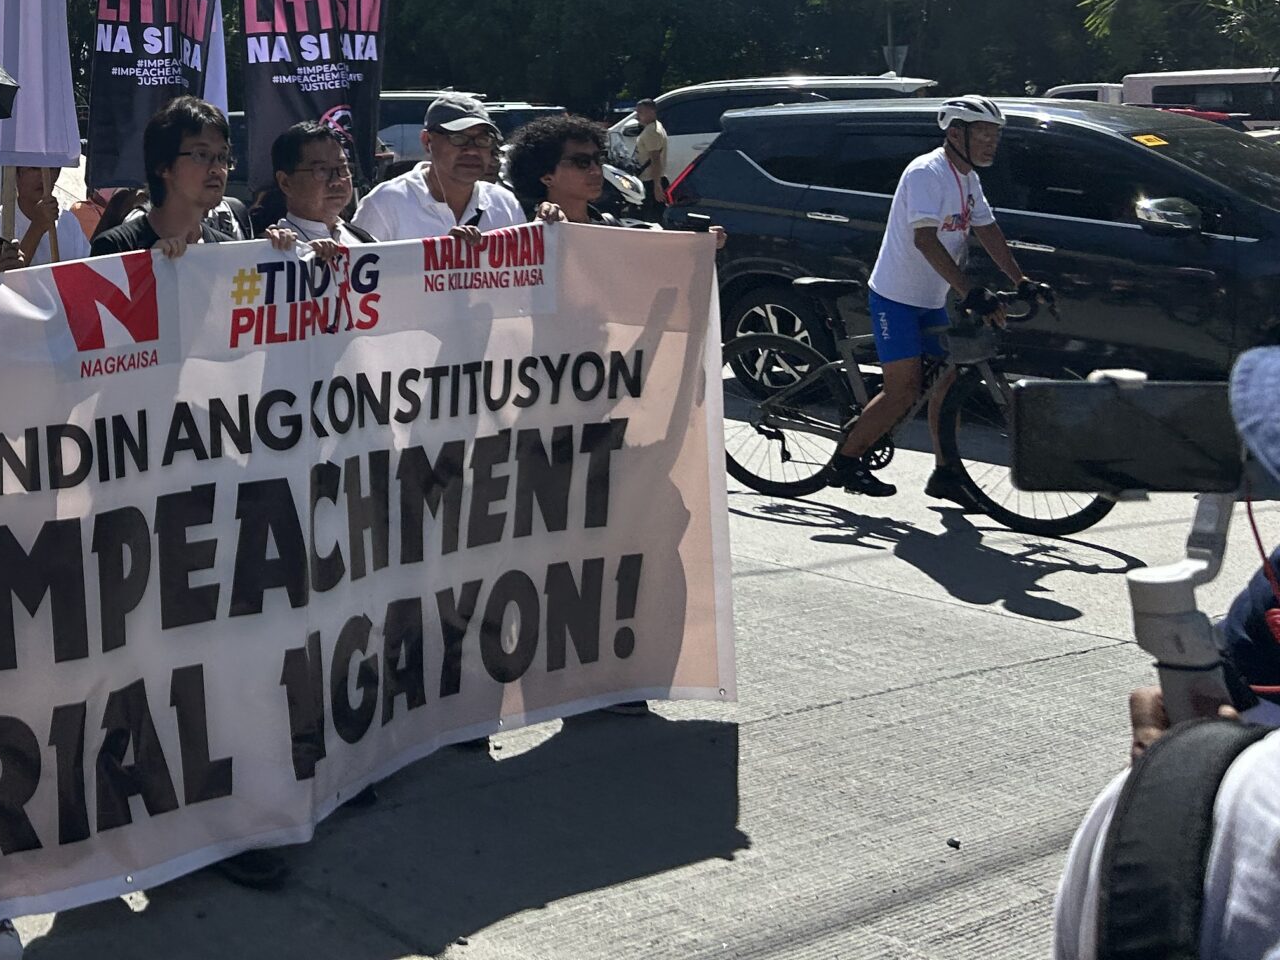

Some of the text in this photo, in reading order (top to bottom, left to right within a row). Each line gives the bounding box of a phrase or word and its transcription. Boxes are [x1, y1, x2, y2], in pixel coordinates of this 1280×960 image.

[96, 23, 133, 54] NA
[143, 26, 174, 55] SI
[247, 35, 293, 64] NA
[299, 33, 331, 61] SI
[422, 224, 545, 271] KALIPUNAN
[424, 268, 545, 292] NG KILUSANG MASA
[80, 348, 160, 379] NAGKAISA
[162, 388, 303, 468] ANG
[280, 553, 644, 782] NGAYON!
